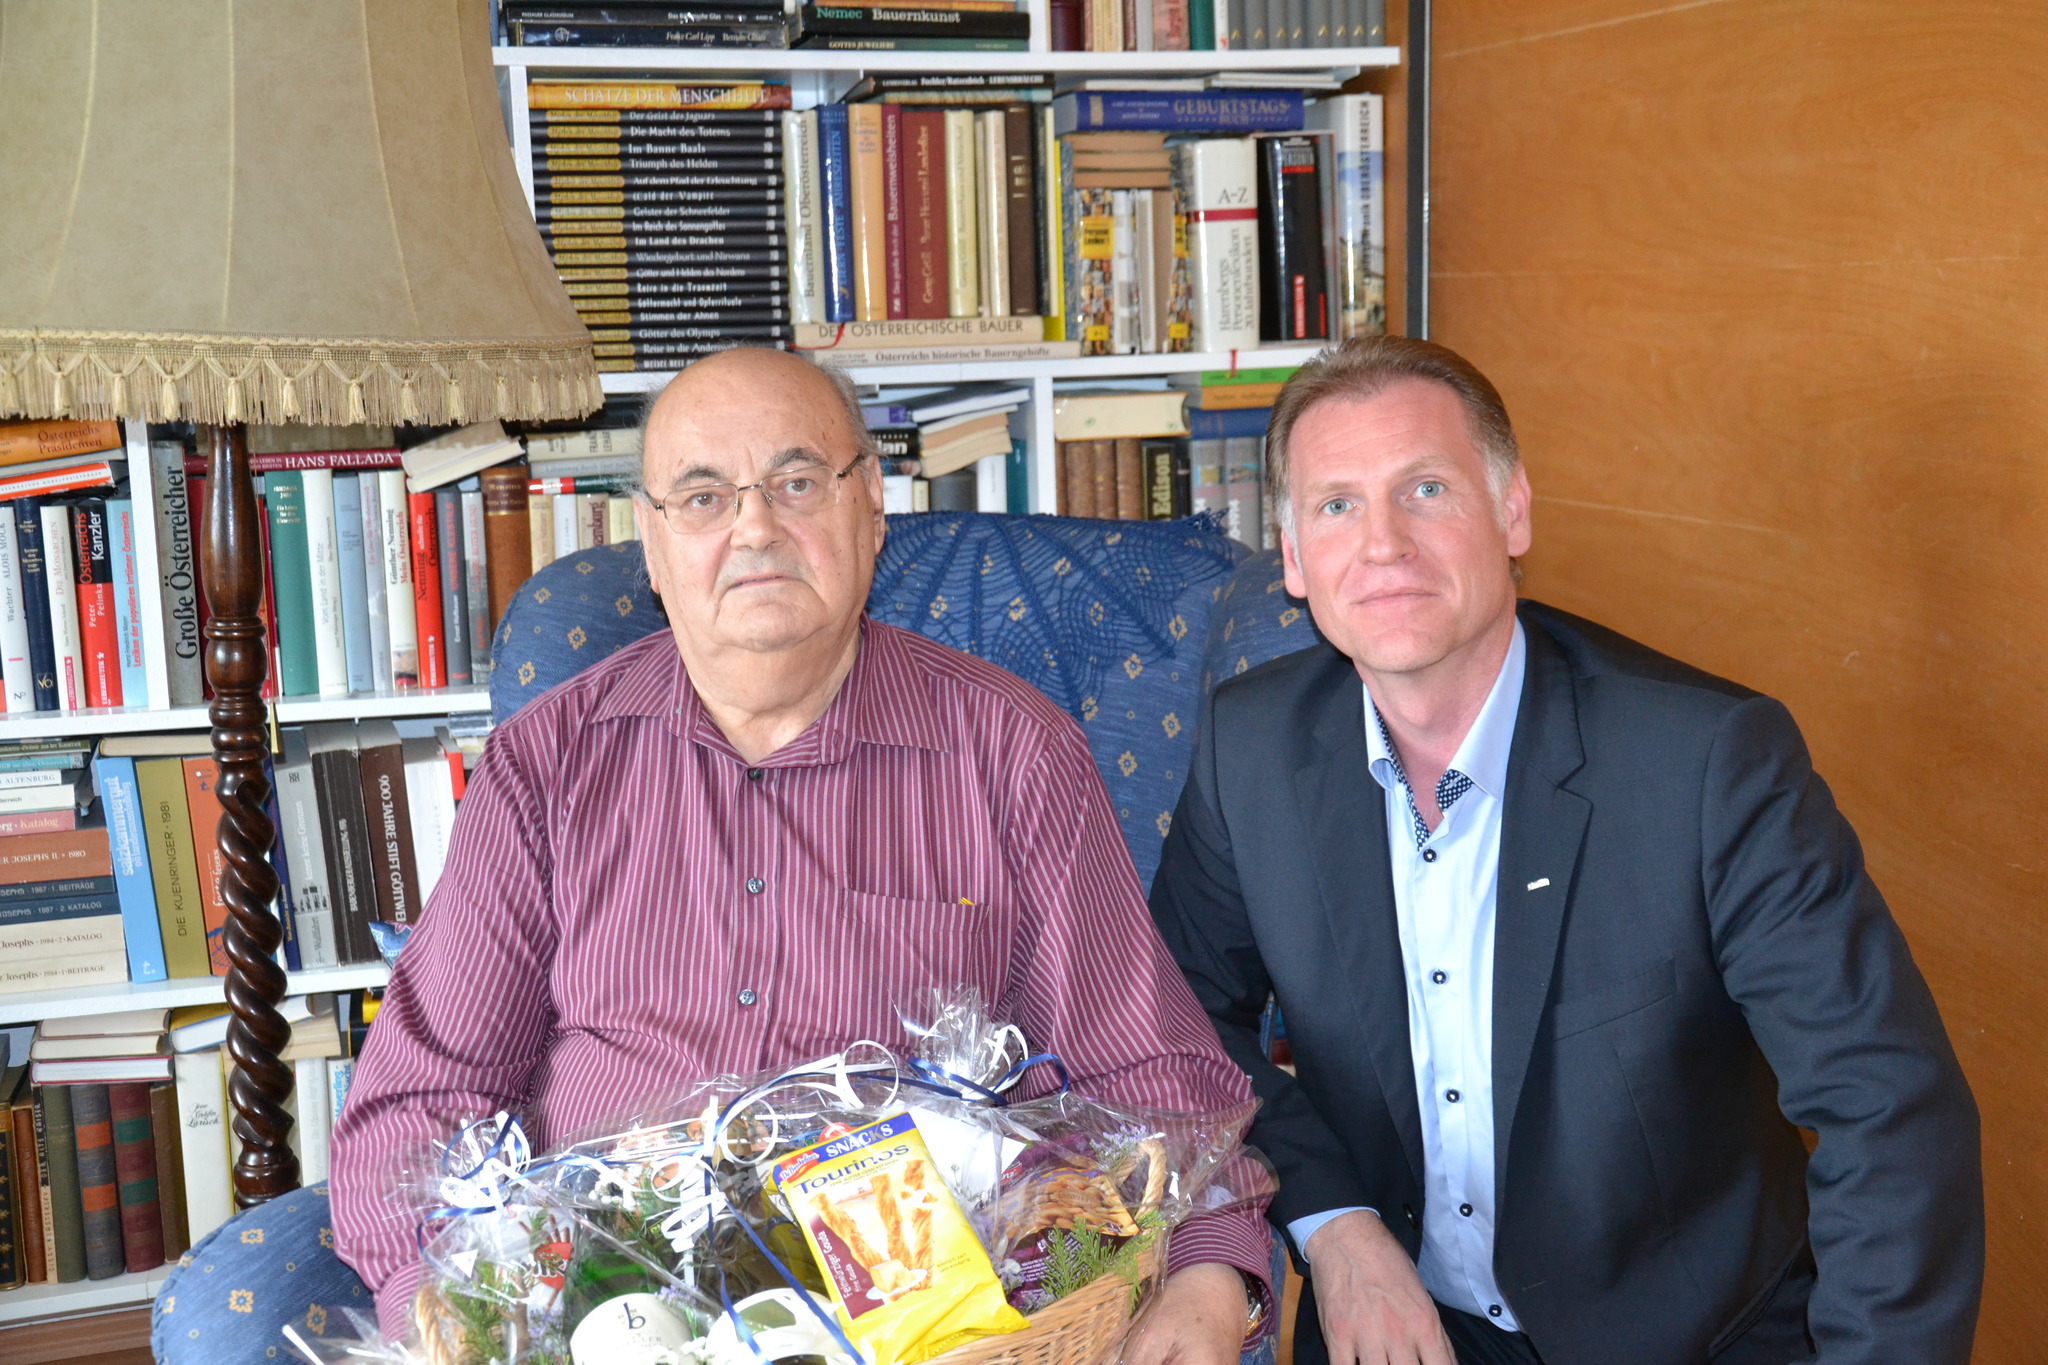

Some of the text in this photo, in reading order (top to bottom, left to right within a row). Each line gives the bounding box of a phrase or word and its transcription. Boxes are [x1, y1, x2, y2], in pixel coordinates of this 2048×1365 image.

[817, 7, 960, 23] Nemec Bauernkunst
[636, 89, 664, 102] DER
[670, 89, 767, 103] MENSCHHEIT
[630, 111, 715, 123] Der Geist des Jaguars
[631, 127, 730, 137] Die Macht des Totems
[629, 144, 642, 153] Im
[647, 144, 676, 153] Banne
[680, 144, 706, 153] Baals
[1358, 100, 1370, 200] OBERÖSTERREICH
[630, 159, 718, 169] Triumph des Helden
[831, 131, 843, 208] JAHRESZEITEN
[887, 115, 899, 220] Bauernweisheiten
[634, 176, 757, 185] Auf dem Pfad der Erleuchtung
[660, 191, 673, 200] der
[678, 191, 714, 201] Vampire
[634, 207, 730, 216] Geister der Schneefelder
[798, 120, 815, 297] Bauernland Oberösterreich
[633, 221, 677, 231] Im Reich des
[836, 215, 845, 247] FESTE
[635, 236, 724, 245] Im Land des Drachen
[636, 251, 750, 264] Wiedergeburt und Nirwana
[661, 268, 745, 277] und Helden des Nordens
[1230, 228, 1242, 330] Personenlexikon
[1243, 236, 1254, 311] Jahrhundert
[661, 283, 683, 292] in die
[1219, 259, 1230, 330] Harenbergs
[684, 298, 696, 307] und
[640, 312, 719, 321] Stimmen der Ahnen
[639, 327, 720, 338] Götter des Olymps
[852, 320, 972, 336] ÖSTERREICHISCHE
[979, 320, 1023, 333] BAUER
[643, 344, 663, 353] Reise
[666, 344, 675, 353] in
[678, 344, 689, 352] die
[876, 352, 929, 361] Österreichs
[932, 351, 981, 360] historische
[984, 349, 1049, 359] Bauerngehöfte
[40, 439, 102, 454] Präsidenten
[285, 453, 394, 468] HANS FALLADA
[1152, 454, 1171, 515] Edison
[445, 503, 455, 547] KLESTILS
[89, 512, 104, 560] Kanzler
[316, 542, 324, 562] Mitte
[386, 509, 398, 584] Günther Nenning
[396, 511, 408, 583] Mein Österreich
[50, 522, 64, 595] DIE MONARCHEN
[163, 465, 198, 659] Große Österreicher
[415, 552, 427, 600] Nenning
[448, 551, 458, 590] UNSERE
[2, 553, 15, 622] Wachter ALOIS
[120, 512, 141, 667] Lexikon der populären Irrtümer Österreichs
[319, 588, 328, 605] Land
[96, 583, 105, 616] Pelinka
[320, 607, 328, 624] Vom
[5, 775, 55, 783] ALTENBURG
[378, 775, 390, 800] 900
[21, 819, 59, 829] Katalog
[104, 776, 134, 876] salzkammergut
[382, 801, 396, 838] JAHRE
[295, 801, 313, 881] kennt keine Grenzen
[68, 850, 86, 858] 1980
[388, 842, 399, 870] STIFT
[160, 801, 188, 936] DIE KUENRINGER 1981
[68, 901, 102, 911] KATALOG
[2, 933, 103, 949] Josephs KATALOG
[312, 917, 322, 950] Wallfahrt
[6, 972, 38, 981] Josephs
[825, 1123, 894, 1158] SNACKS
[793, 1144, 909, 1194] Tourinos
[818, 1230, 853, 1299] Feinwürziger Gouda
